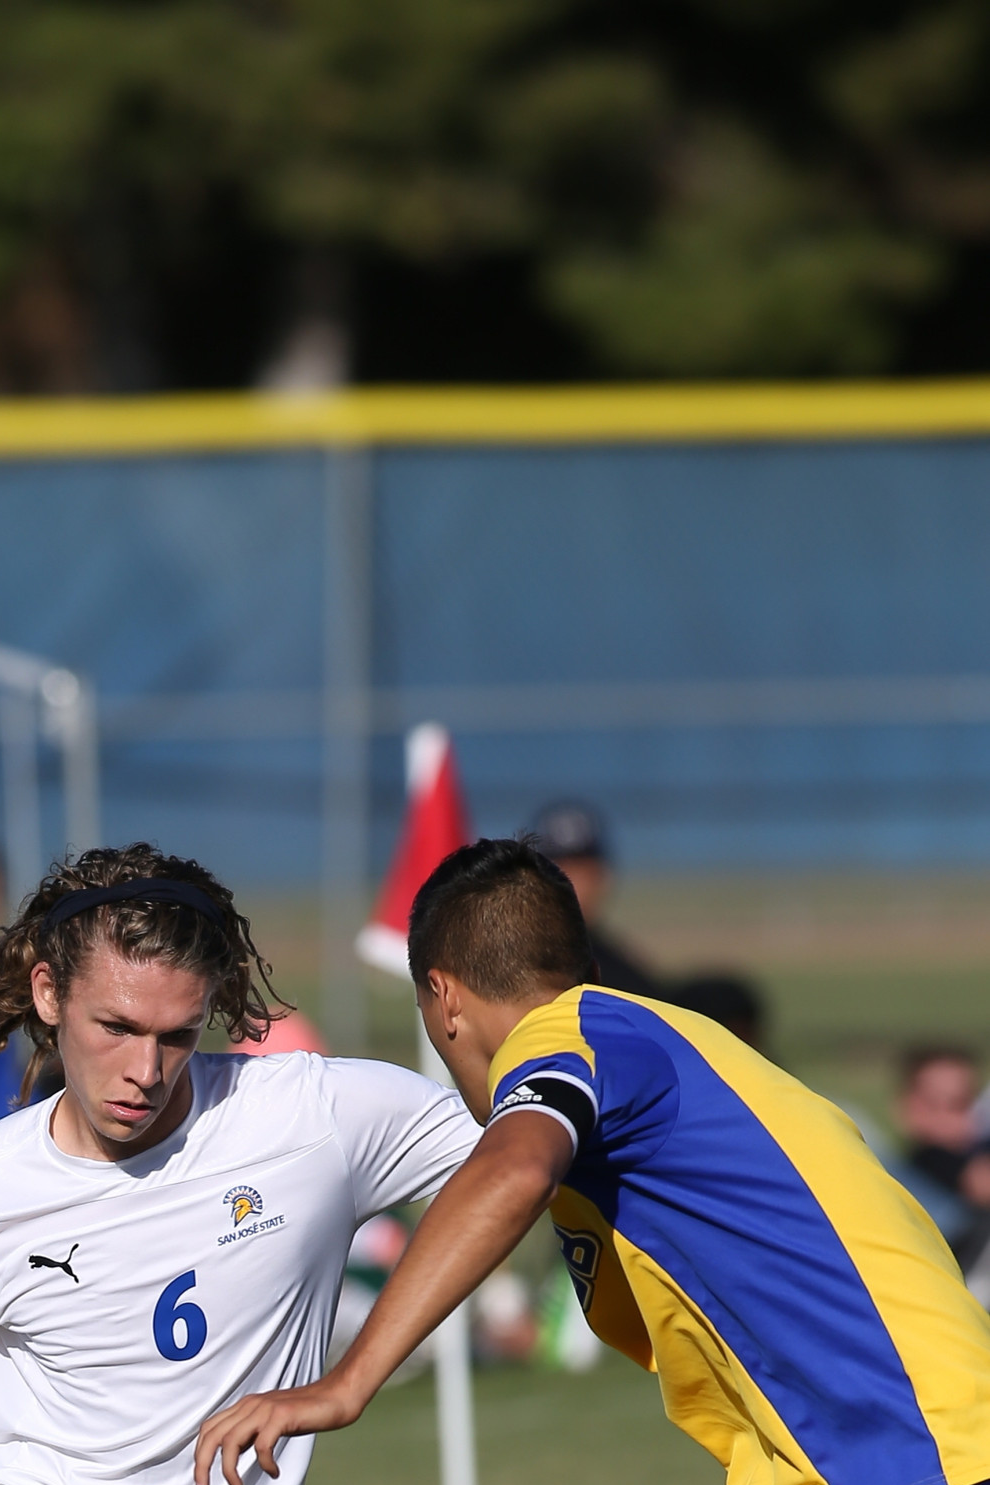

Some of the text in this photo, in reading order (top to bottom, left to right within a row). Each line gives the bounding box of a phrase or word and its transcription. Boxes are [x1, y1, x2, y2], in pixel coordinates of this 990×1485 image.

[217, 1214, 286, 1247] SAN JOSÉ STATE
[153, 1269, 208, 1362] 6
